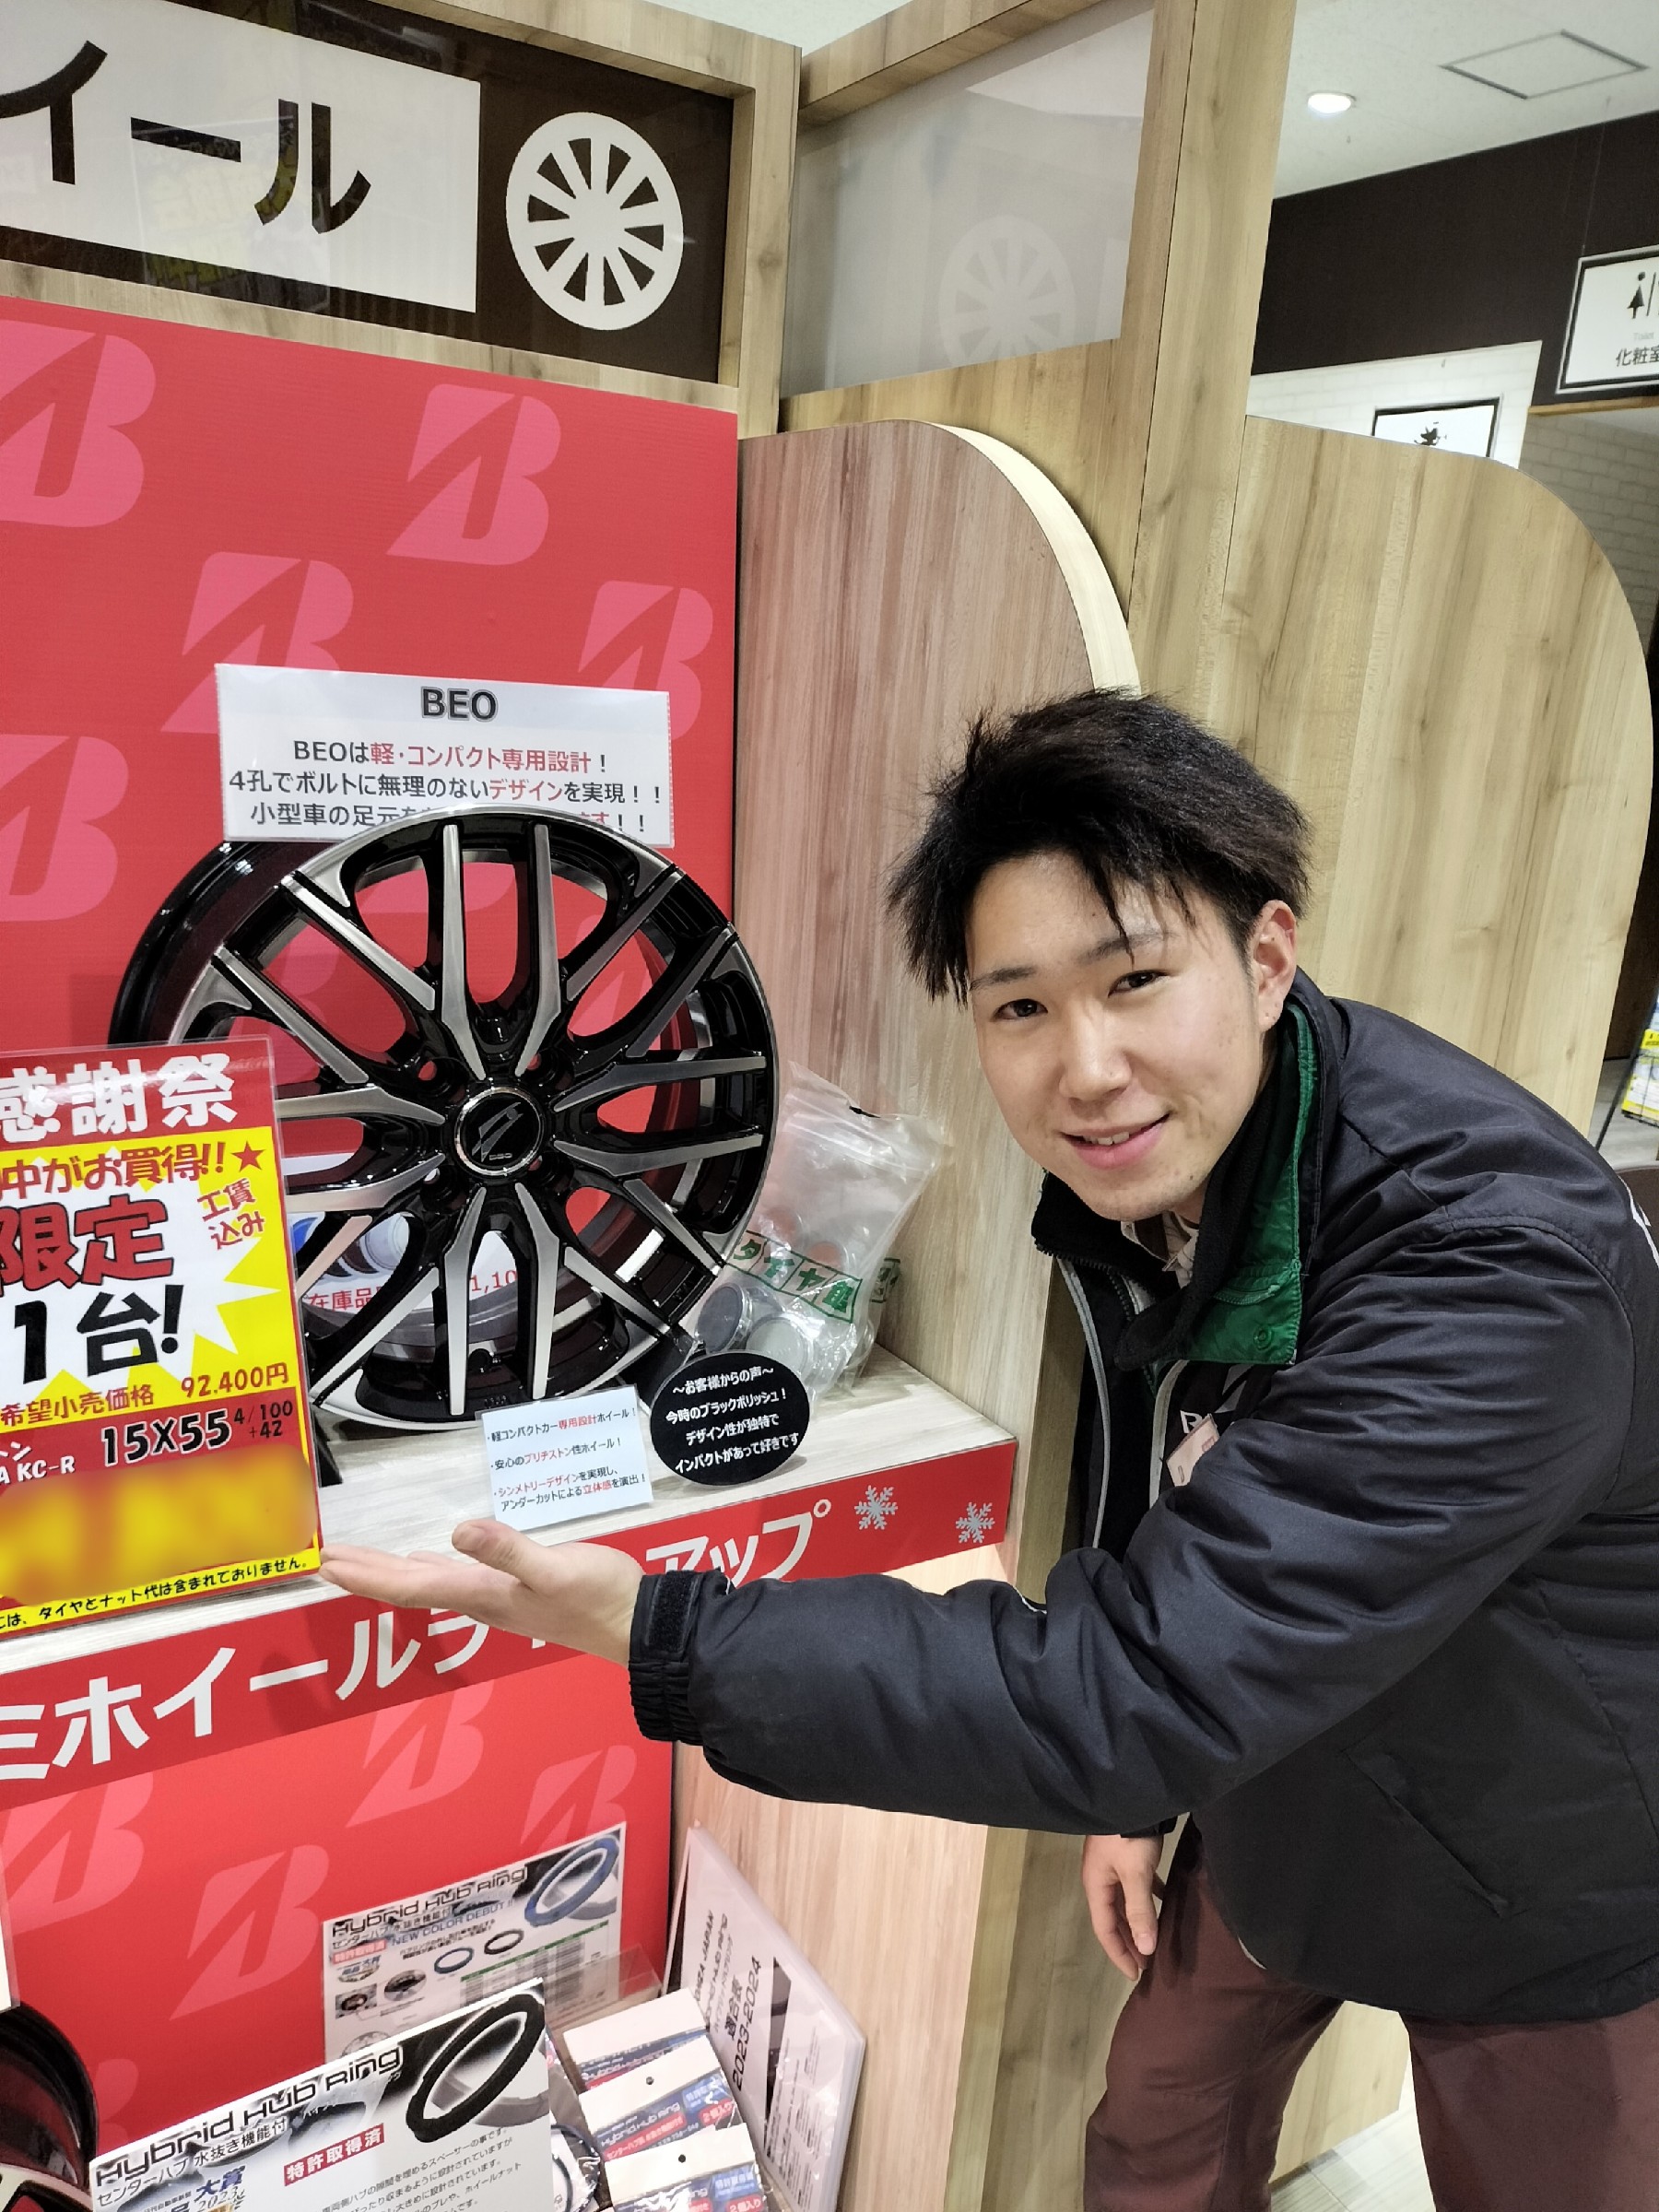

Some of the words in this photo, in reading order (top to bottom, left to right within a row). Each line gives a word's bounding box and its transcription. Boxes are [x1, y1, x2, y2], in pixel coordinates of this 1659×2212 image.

[421, 687, 499, 722] BEO
[0, 1053, 237, 1142] 感謝祭
[197, 1178, 255, 1222] 工賃
[0, 1194, 174, 1291] 限定
[208, 1210, 265, 1250] 込み
[309, 1287, 382, 1312] 在庫品
[470, 1269, 518, 1294] 1,10
[1, 1384, 154, 1427] 希望小売価格
[686, 1414, 780, 1446] デザイン性が独特で
[675, 1432, 799, 1473] インパクトがあって好きです
[0, 1607, 546, 1781] ミホイールラ
[332, 1900, 418, 1937] Hybrid
[392, 1931, 418, 1946] NEW
[423, 1917, 462, 1935] COLOR
[733, 1955, 761, 2091] 2023-2024
[97, 2111, 234, 2186] Hybrid
[244, 2082, 316, 2126] Hub
[287, 2128, 381, 2181] 特許取得済
